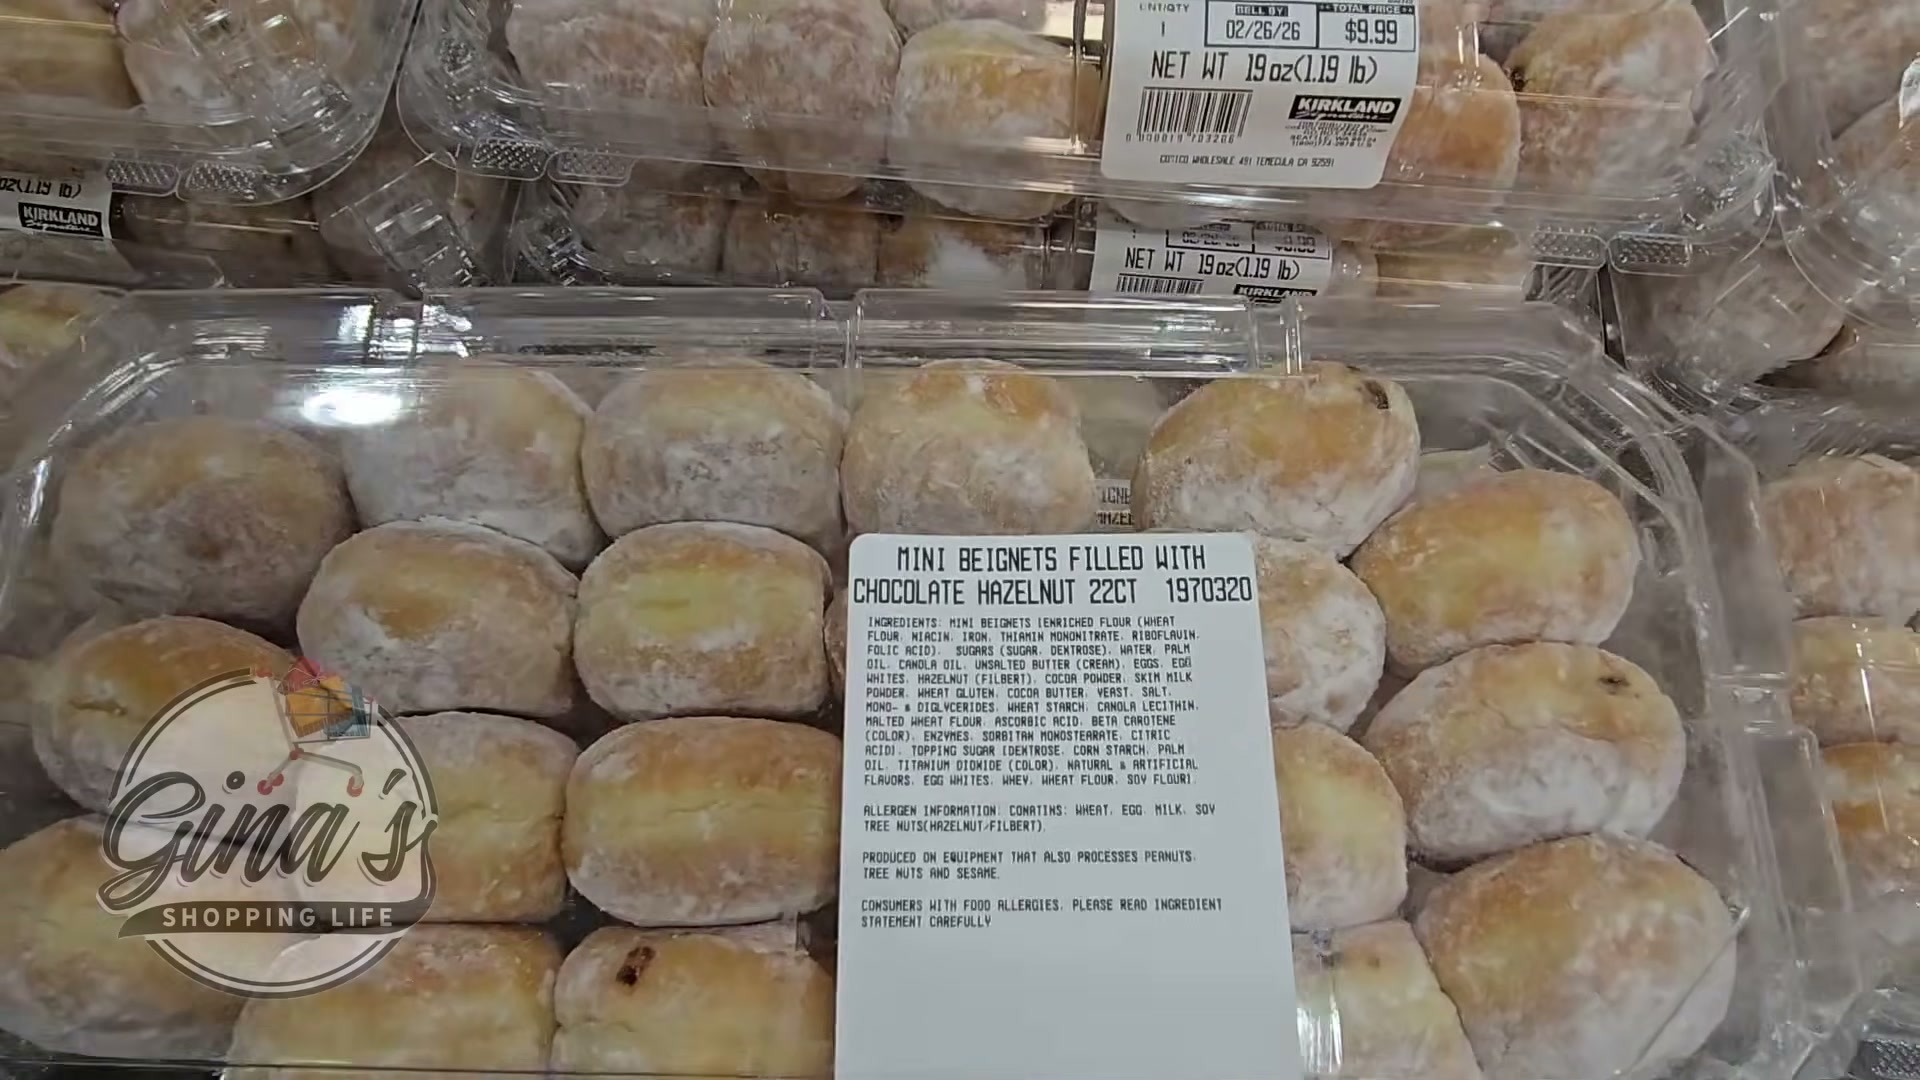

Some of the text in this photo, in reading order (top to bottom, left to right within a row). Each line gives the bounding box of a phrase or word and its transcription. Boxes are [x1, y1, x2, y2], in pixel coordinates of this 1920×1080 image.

[1226, 20, 1301, 41] 02/26/26
[1345, 18, 1399, 45] $9.99
[1151, 51, 1191, 79] NET
[1202, 52, 1229, 81] WT
[1350, 54, 1378, 84] lb)
[1297, 97, 1396, 114] KIRKLAND
[23, 205, 99, 226] KIRKLAND
[1125, 247, 1156, 270] NET
[1165, 250, 1185, 272] WT
[1278, 258, 1301, 281] lb)
[898, 545, 1205, 571] MINI BEIGNETS FILLED WITH
[853, 576, 1252, 604] CHOCOLATE HAZELNUT 22CT 1970320
[868, 617, 942, 629] INGREDIENTS:
[950, 617, 974, 629] MINI
[980, 616, 1031, 628] BEIGNETS
[1100, 616, 1132, 628] FLOUR
[1137, 616, 1175, 628] (WHEAT
[1001, 630, 1044, 642] THIAMIN
[867, 644, 899, 656] FOLIC
[956, 644, 994, 656] SUGARS
[1164, 643, 1190, 655] PALM
[899, 659, 937, 671] CANOLA
[975, 659, 1026, 671] UNSALTED
[1032, 658, 1070, 670] BUTTER
[917, 673, 968, 685] HAZELNUT
[1044, 672, 1078, 684] COCOA
[1134, 671, 1160, 683] SKIM
[1166, 671, 1193, 683] MILK
[917, 688, 950, 700] WHEAT
[1007, 687, 1040, 699] COCOA
[866, 702, 898, 714] MONO-
[1007, 701, 1040, 713] WHEAT
[1097, 700, 1136, 712] CANOLA
[865, 716, 905, 728] MALTED
[910, 716, 943, 728] WHEAT
[994, 715, 1047, 727] ASCORBIC
[1091, 715, 1118, 727] BETA
[1123, 715, 1176, 727] CAROTENE
[982, 730, 1034, 742] SORBITAN
[1131, 729, 1171, 741] CITRIC
[912, 745, 957, 757] TOPPING
[962, 745, 996, 757] SUGAR
[1073, 744, 1100, 756] CORN
[1158, 743, 1185, 755] PALM
[898, 760, 950, 772] TITANIUM
[956, 759, 1002, 771] DIOXIDE
[1067, 758, 1113, 770] NATURAL
[1132, 758, 1199, 770] ARTIFICIAL
[923, 774, 944, 786] EGG
[1041, 774, 1074, 786] WHEAT
[1127, 773, 1147, 785] SOY
[863, 804, 917, 816] ALLERGEN
[1195, 803, 1216, 815] SOY
[864, 820, 890, 833] TREE
[862, 851, 916, 864] PRODUCED
[923, 851, 937, 864] ON
[943, 851, 1003, 864] EQUIPMENT
[1011, 851, 1037, 864] THAT
[1043, 850, 1071, 863] ALSO
[1077, 850, 1138, 863] PROCESSES
[863, 867, 889, 880] TREE
[895, 867, 923, 880] NUTS
[930, 867, 950, 880] AND
[861, 899, 923, 912] CONSUMERS
[929, 899, 957, 912] WITH
[963, 899, 991, 912] FOOD
[1072, 898, 1113, 911] PLEASE
[1120, 898, 1148, 911] READ
[1154, 898, 1222, 911] INGREDIENT
[861, 915, 992, 928] STATEMENT CAREFULLY
